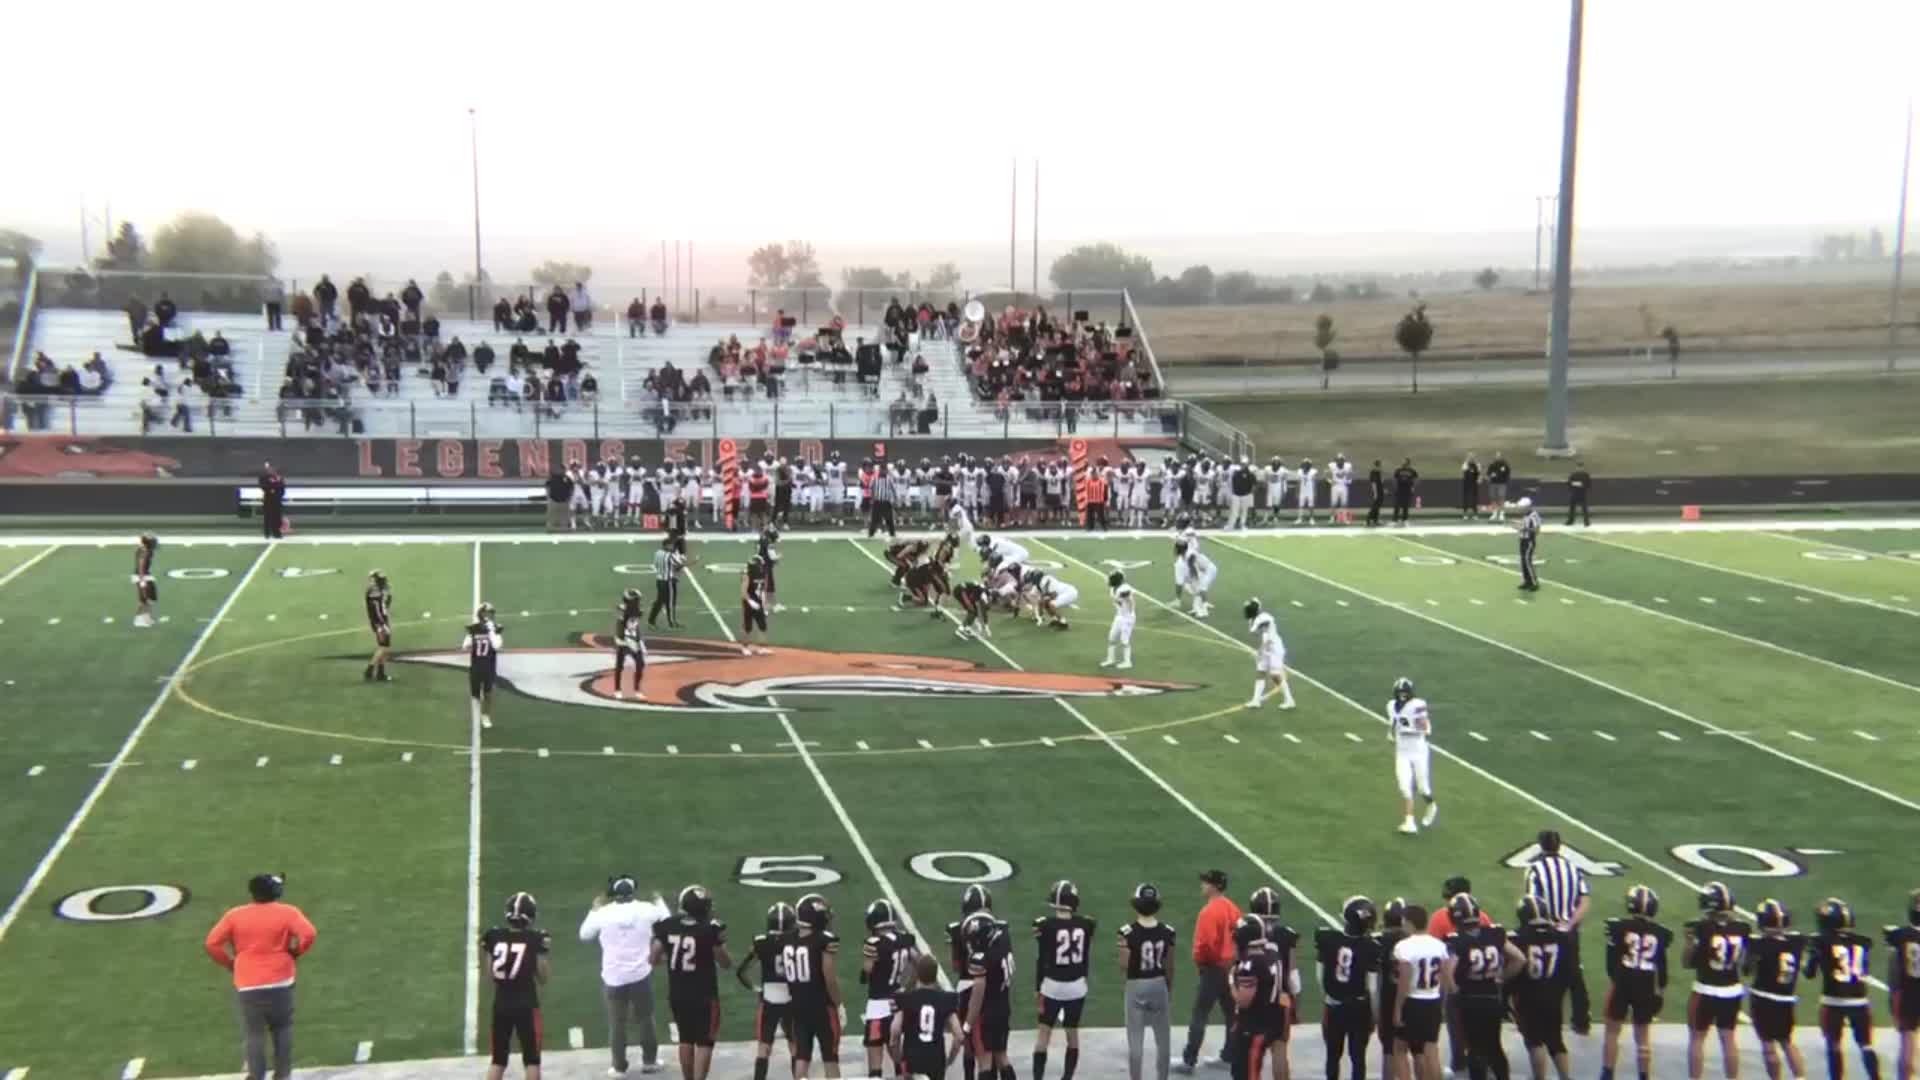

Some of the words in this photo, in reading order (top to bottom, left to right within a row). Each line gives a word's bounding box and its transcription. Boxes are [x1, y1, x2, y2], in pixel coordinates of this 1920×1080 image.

[355, 439, 625, 477] LEGENDS
[664, 439, 824, 472] FID
[492, 941, 527, 980] 27
[667, 934, 696, 972] 72
[783, 945, 810, 982] 60
[1055, 928, 1085, 965] 23
[1468, 945, 1502, 981] 22
[1527, 944, 1559, 979] 67
[1621, 932, 1659, 971] 32
[1708, 934, 1744, 971] 37
[1416, 957, 1440, 990] 12
[919, 1004, 935, 1043] 9
